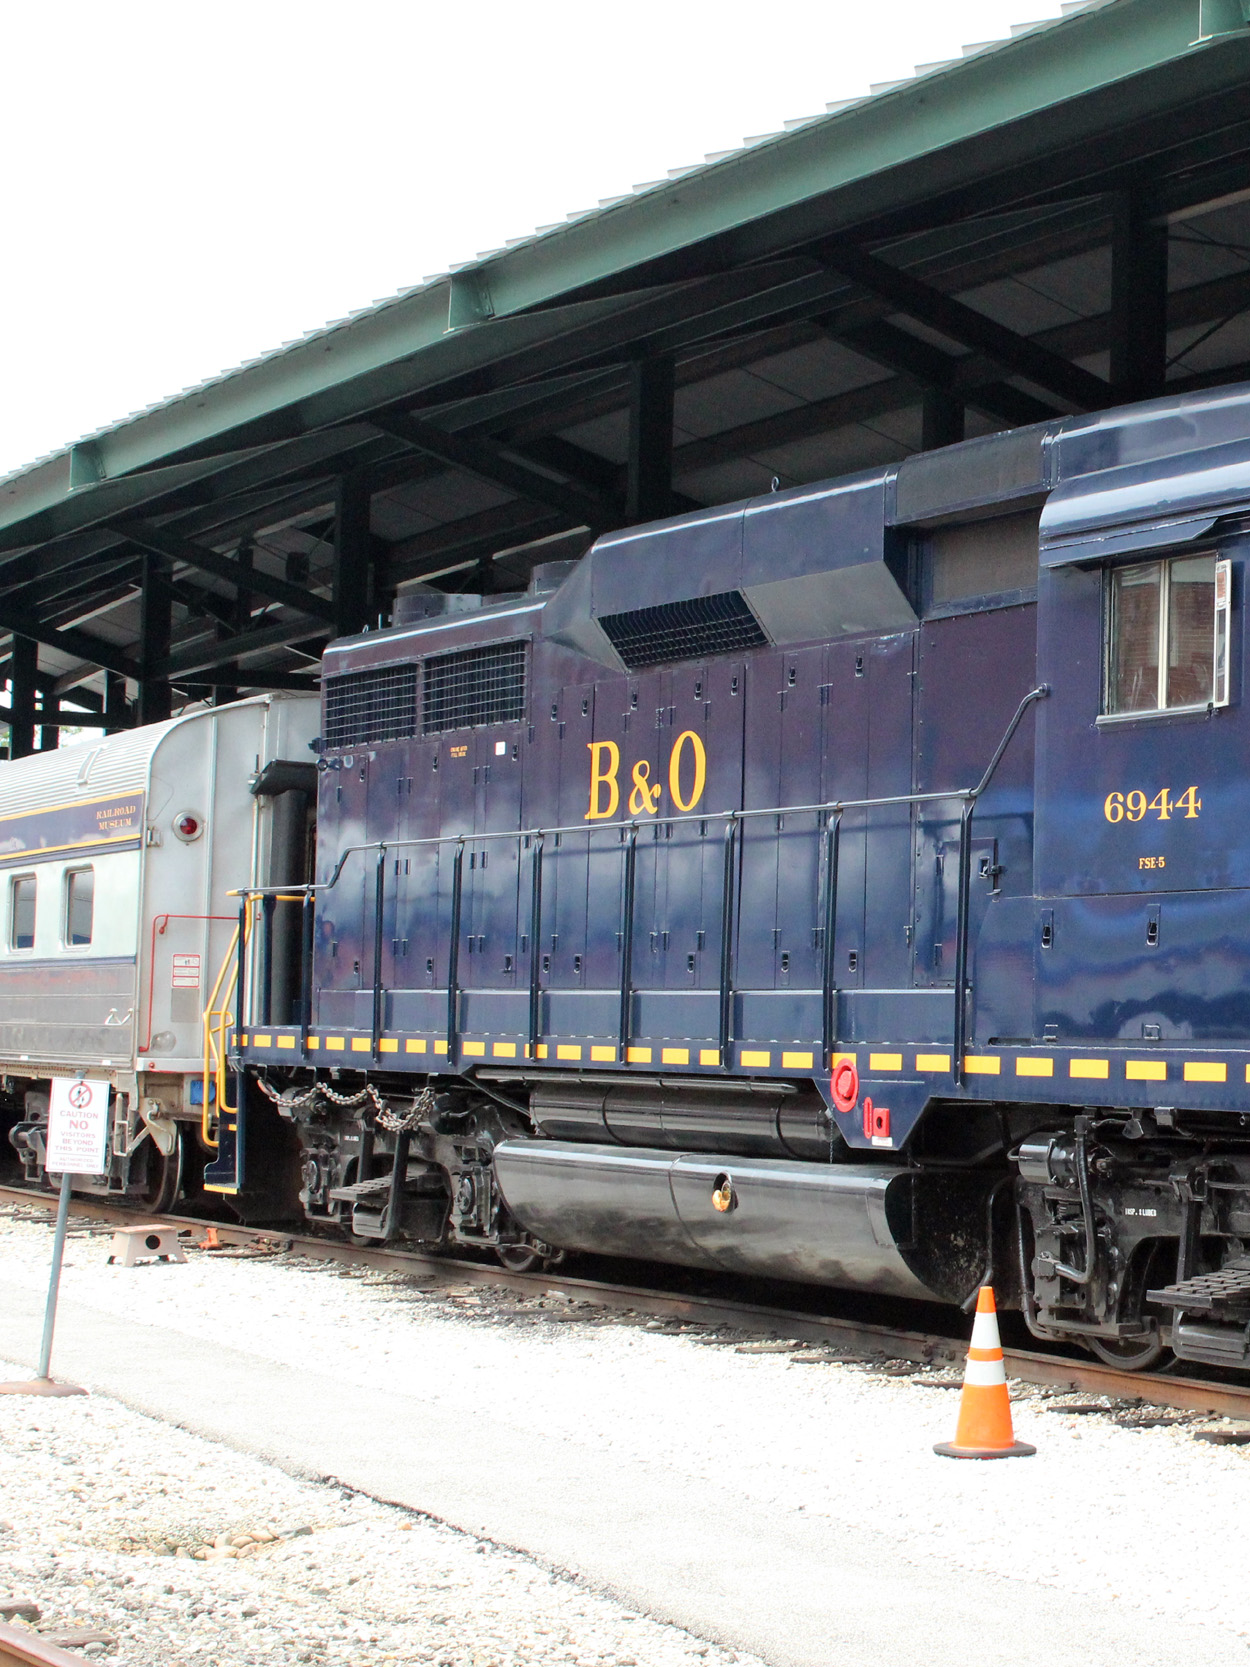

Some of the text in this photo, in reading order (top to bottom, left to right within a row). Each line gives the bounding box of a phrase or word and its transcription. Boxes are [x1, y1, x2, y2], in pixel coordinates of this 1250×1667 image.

[584, 730, 706, 819] B&O
[1104, 786, 1202, 823] 6944
[96, 806, 136, 819] RAILROAD
[99, 818, 132, 830] MUSEUM
[1139, 857, 1166, 869] FSE-5
[60, 1110, 98, 1119] CAUTION
[69, 1119, 89, 1130] NO
[62, 1138, 93, 1146] BEYOND
